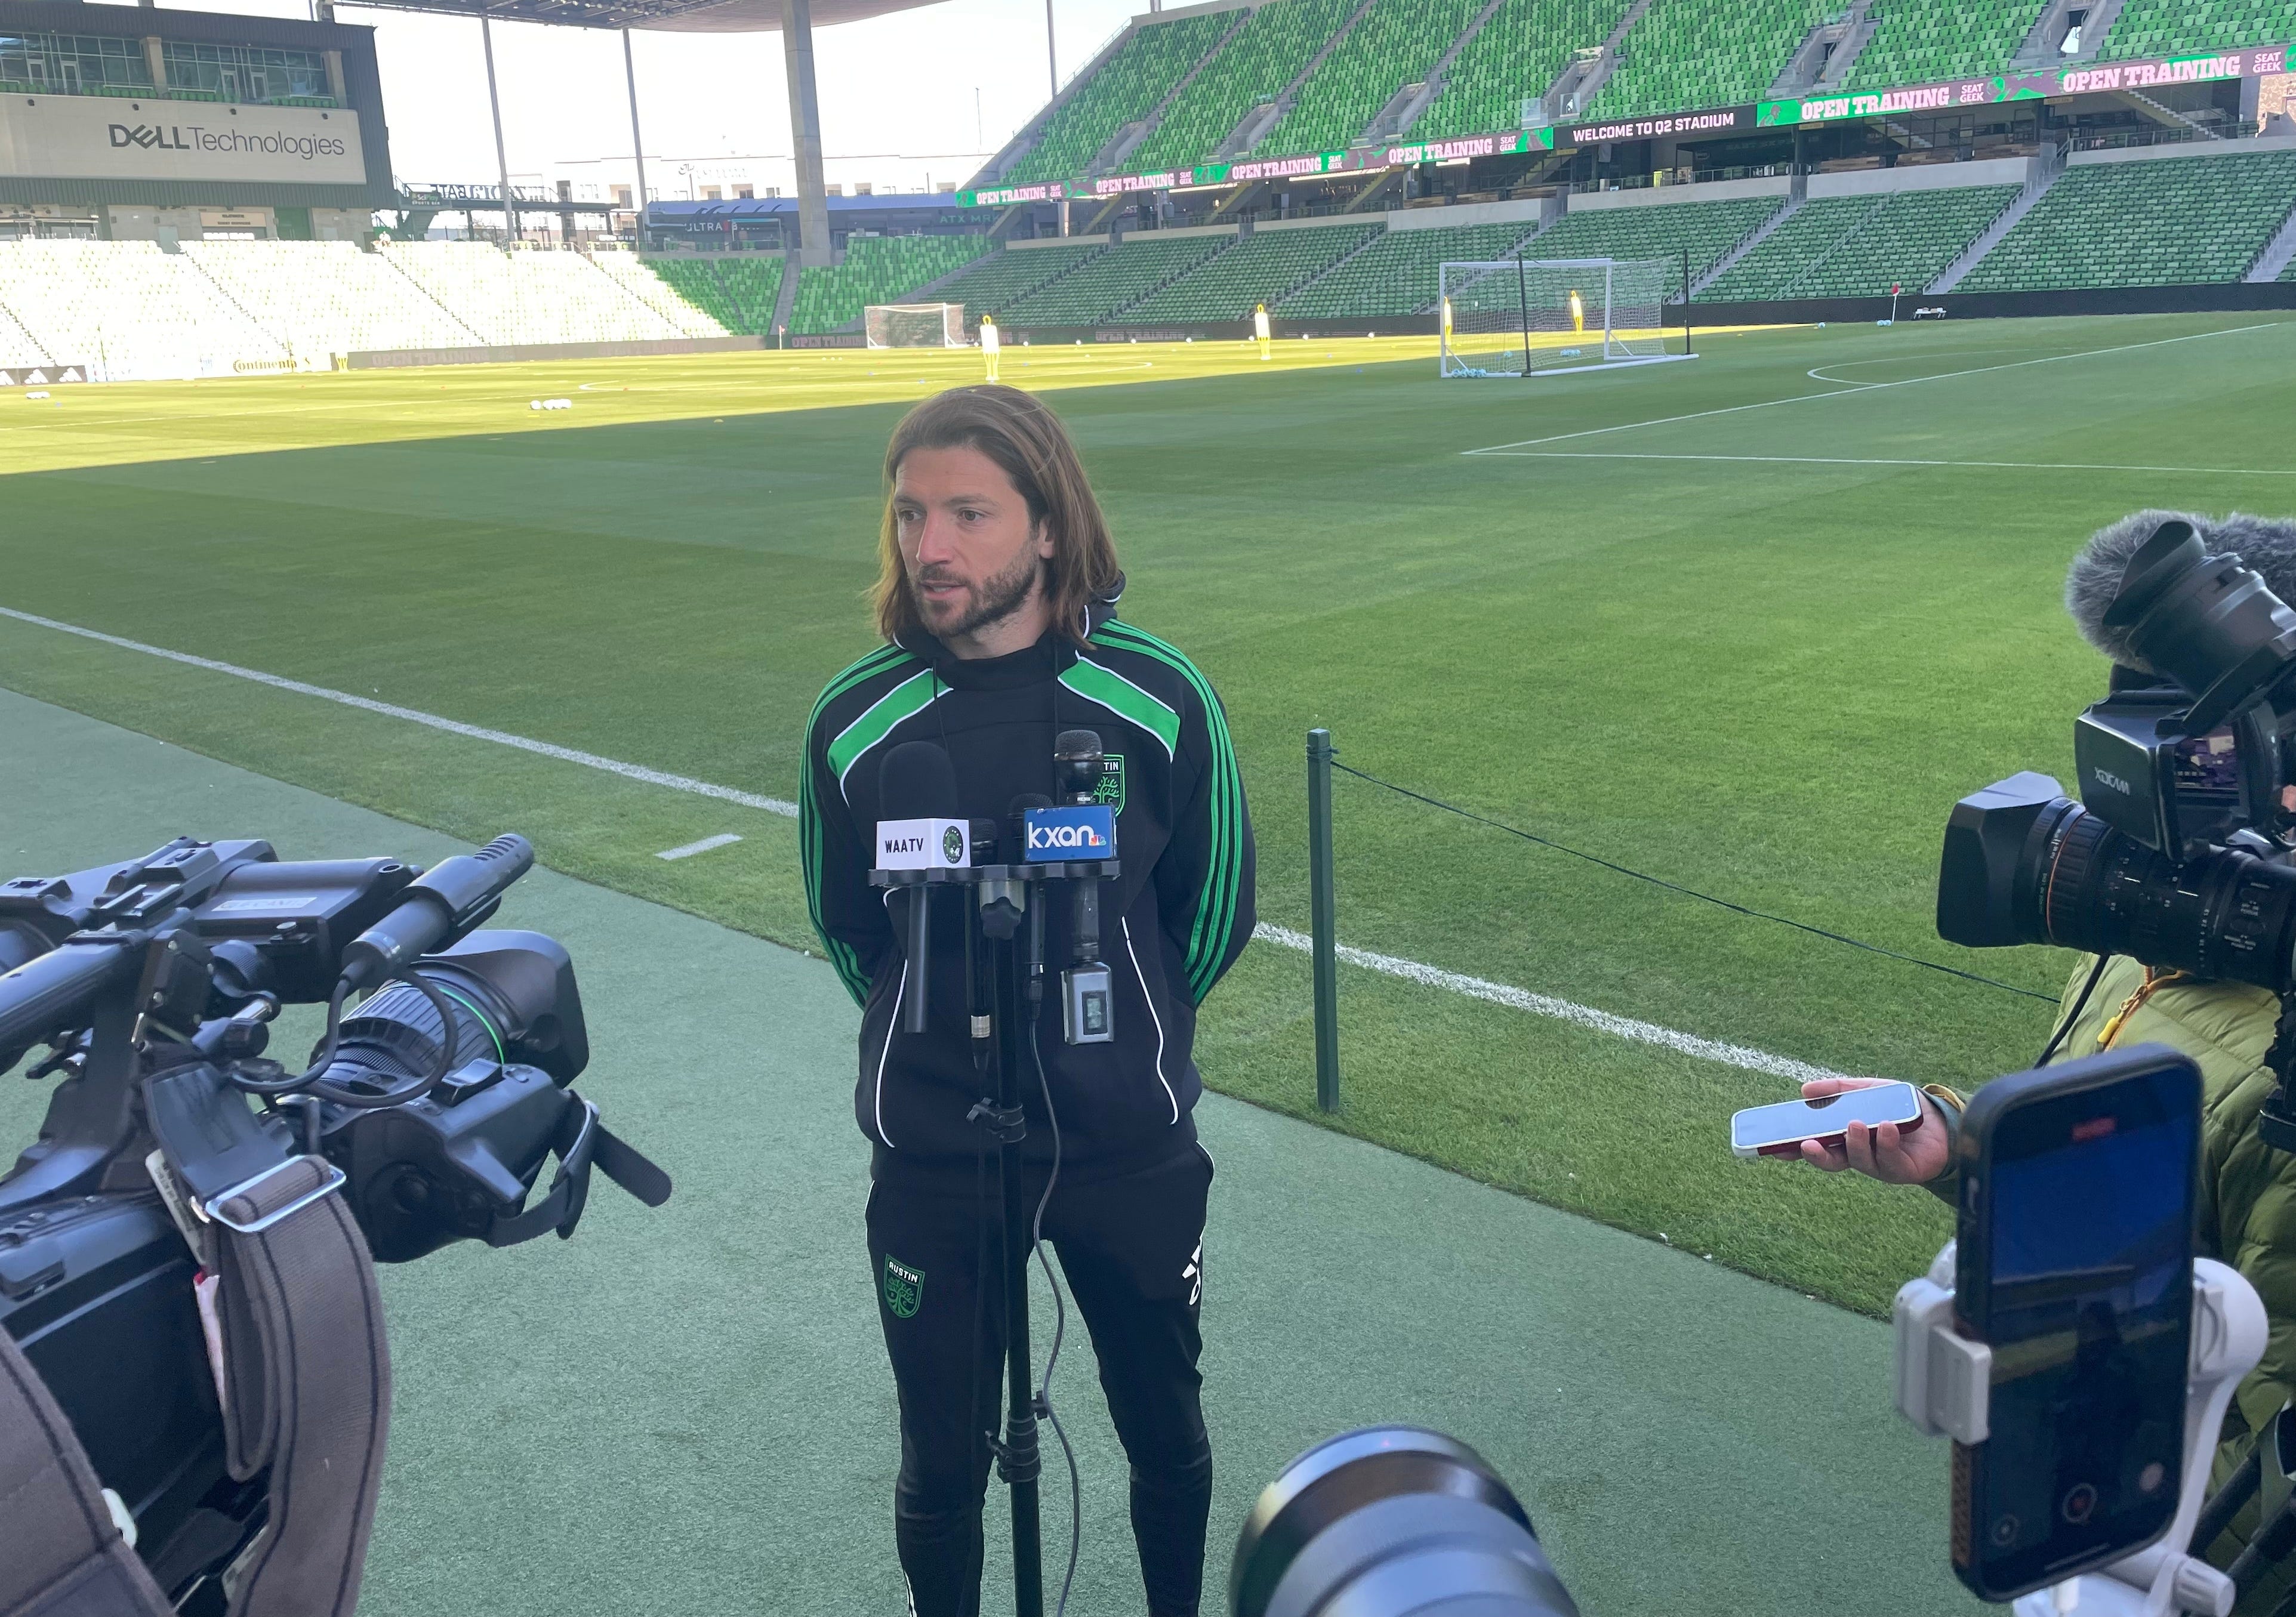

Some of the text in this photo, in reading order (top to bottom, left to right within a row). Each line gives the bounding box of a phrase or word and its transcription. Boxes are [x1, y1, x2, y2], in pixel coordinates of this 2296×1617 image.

[2252, 61, 2282, 73] GEEK
[2254, 52, 2282, 64] SEAT
[2063, 55, 2241, 93] OPEN TRAINING
[1959, 92, 1984, 103] GEEK
[1961, 83, 1984, 94] SEAT
[1801, 87, 1950, 120] OPEN TRAINING
[1573, 112, 1734, 142] WELCOME TO Q2 STADIUM
[108, 124, 345, 160] DELL Technologies
[1499, 143, 1517, 152] GEEK
[1500, 135, 1516, 144] SEAT
[1388, 138, 1493, 164] OPEN TRAINING
[1232, 157, 1322, 180] OPEN TRAINING
[1327, 162, 1343, 170] GEEK
[1096, 173, 1175, 193] OPEN TRAINING
[976, 186, 1046, 205] OPEN TRAINING
[940, 214, 998, 224] ATX MRK
[1028, 821, 1095, 849] kxan
[885, 838, 924, 853] WAATV
[889, 1261, 918, 1283] AUSTIN
